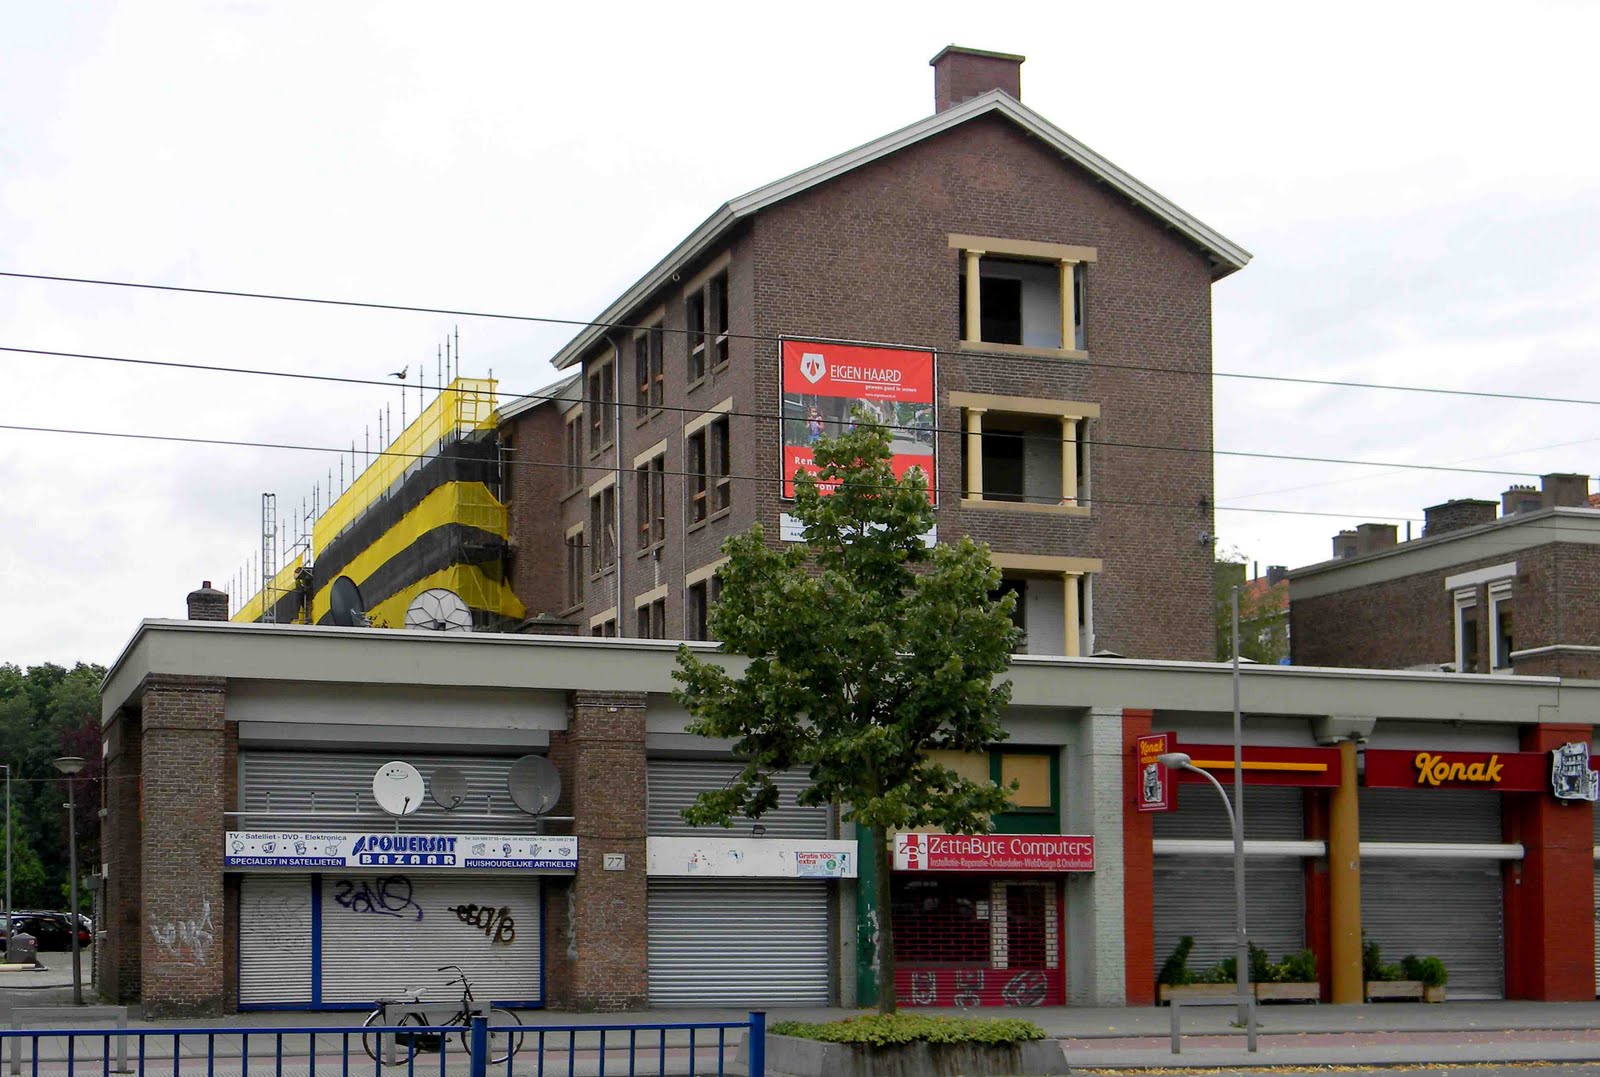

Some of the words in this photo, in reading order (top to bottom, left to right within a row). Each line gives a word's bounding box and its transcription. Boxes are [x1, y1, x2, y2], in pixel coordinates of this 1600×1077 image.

[830, 364, 861, 379] EIGEN
[863, 368, 902, 382] HAARD
[1140, 739, 1164, 755] Konak
[1415, 752, 1504, 786] Konak
[368, 835, 457, 852] POWERSAT
[1010, 839, 1092, 858] Computers
[362, 854, 454, 865] BAZAAR
[899, 842, 926, 862] ZBC
[289, 858, 342, 866] SATELLIETEN
[466, 860, 533, 868] HUISHOUDELIJKE
[534, 860, 576, 868] ARTIKELEN
[608, 857, 622, 867] 77
[1061, 858, 1093, 868] Onderhoud
